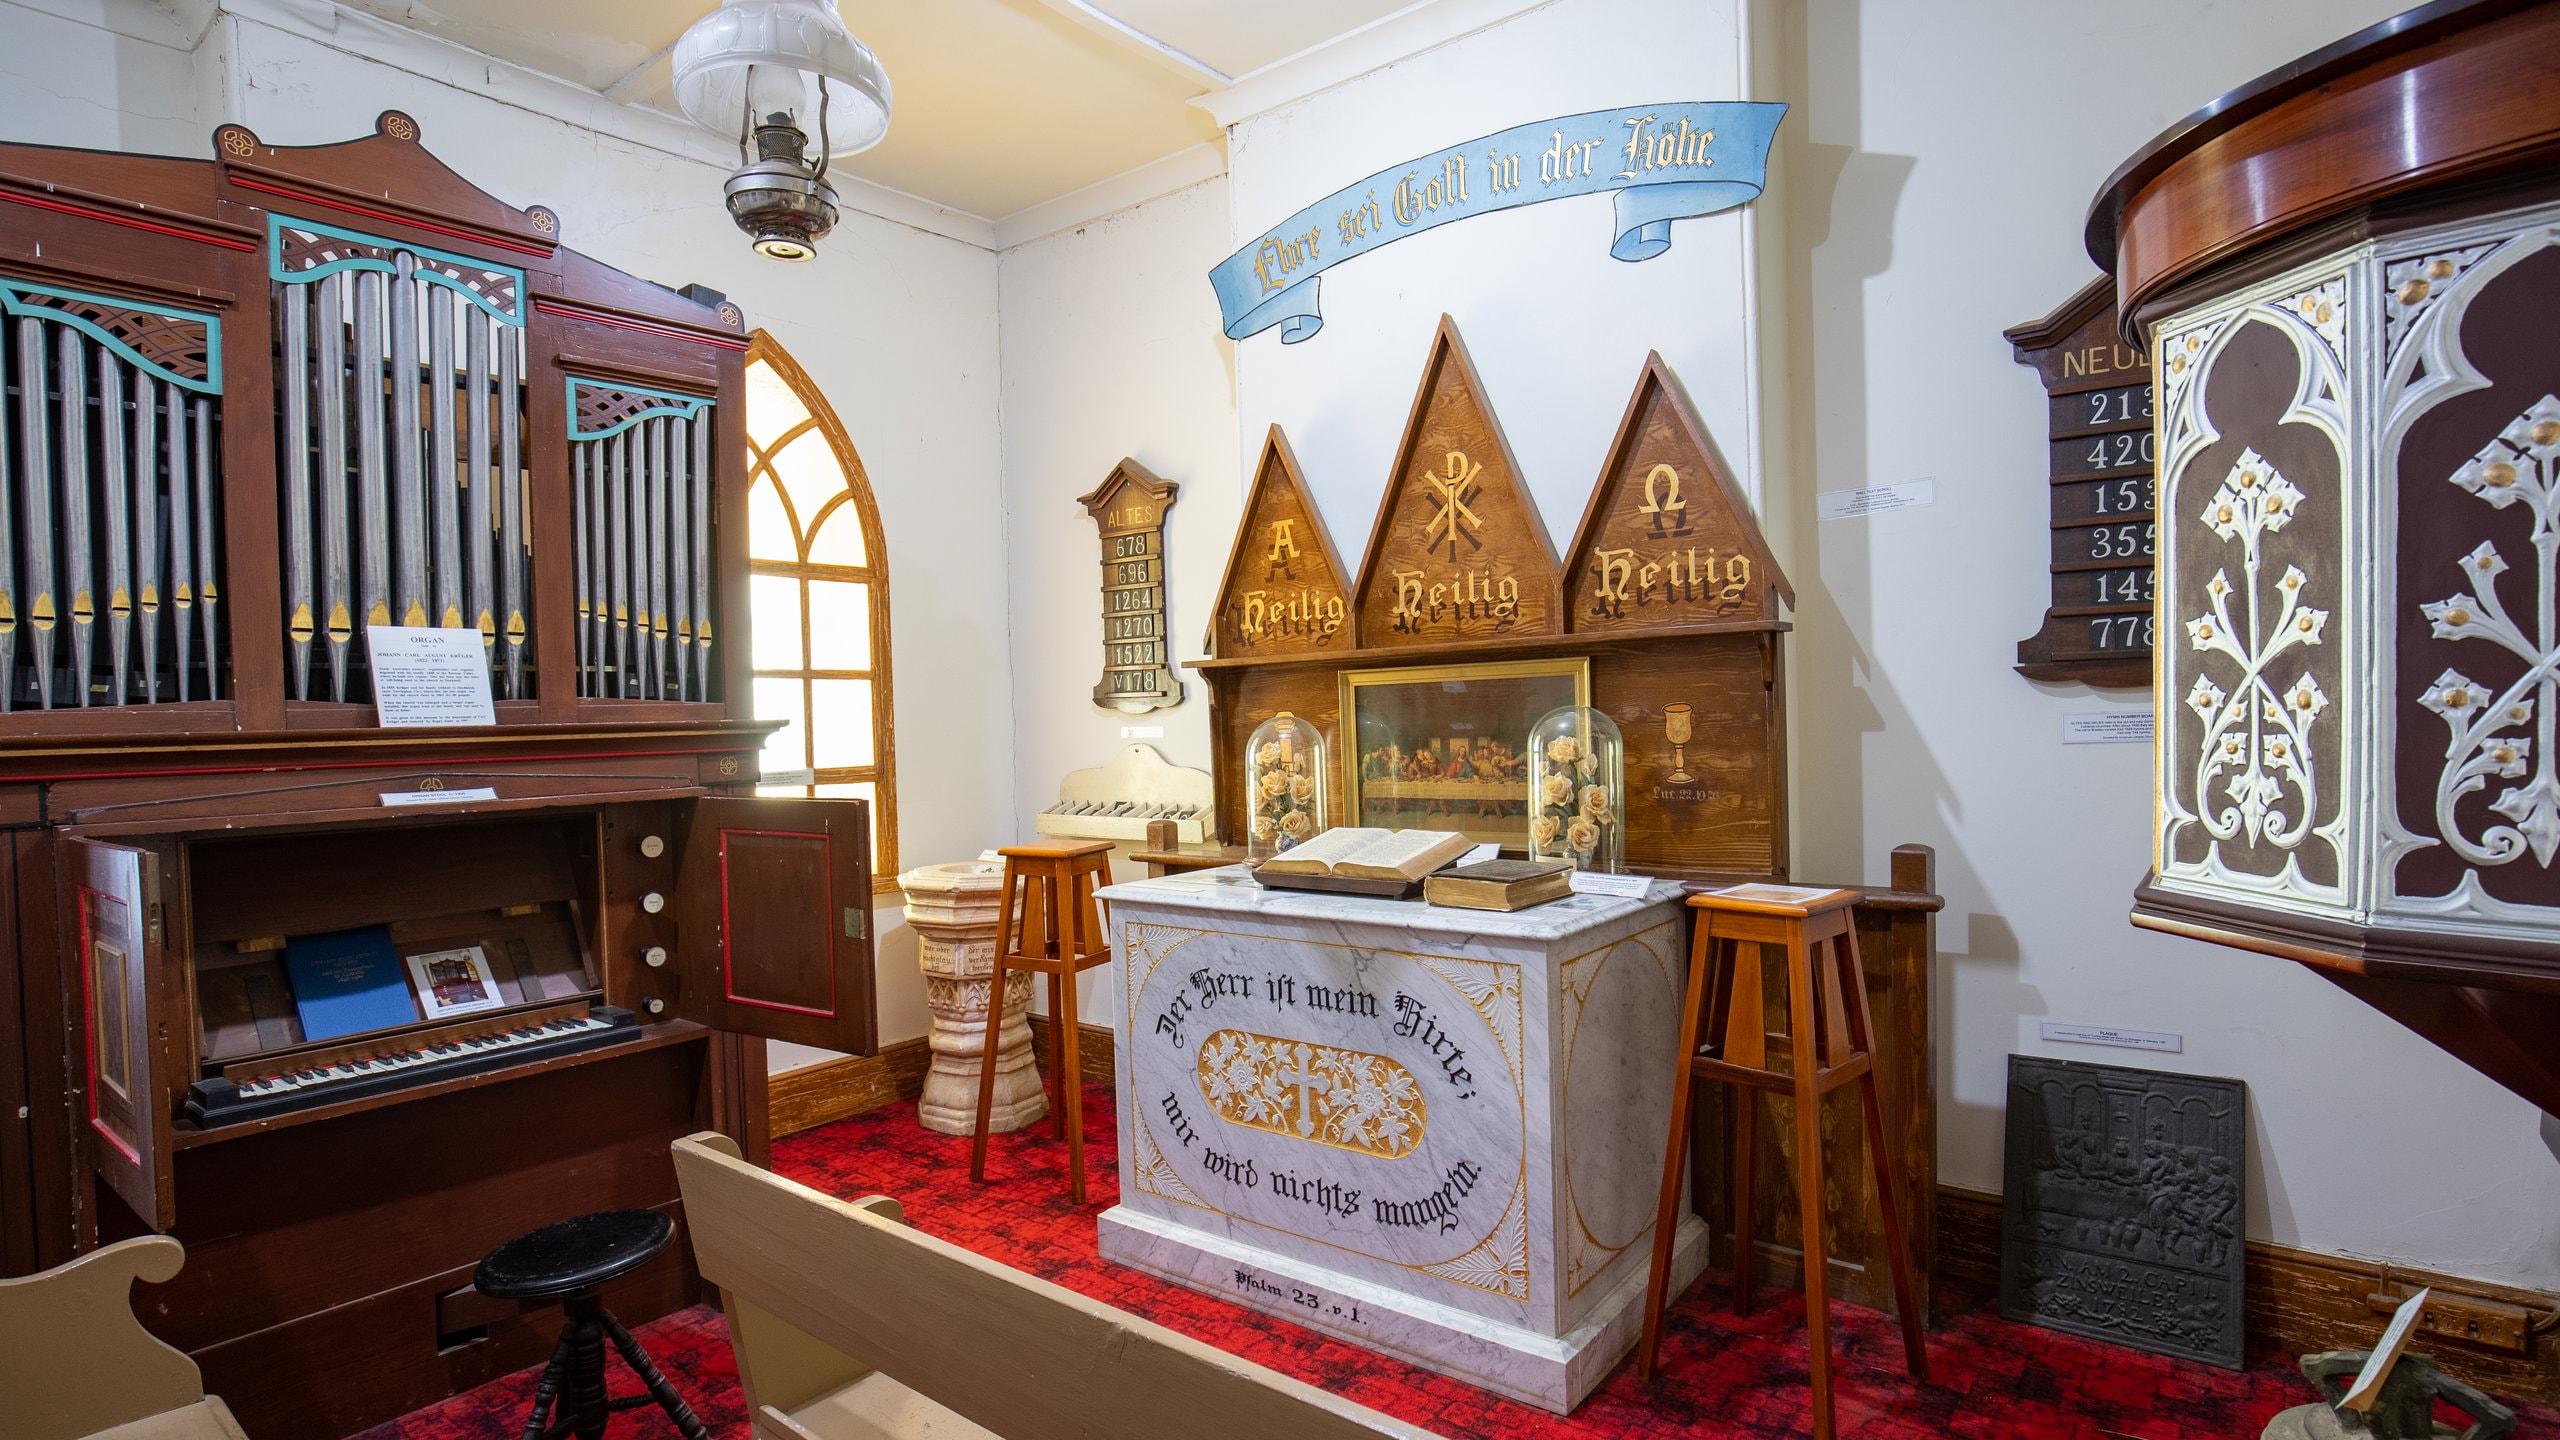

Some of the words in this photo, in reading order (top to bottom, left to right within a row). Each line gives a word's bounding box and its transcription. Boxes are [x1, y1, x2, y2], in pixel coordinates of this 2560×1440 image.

[1254, 225, 1321, 297] Ehre
[1338, 188, 1382, 247] sei
[1393, 151, 1470, 226] Gott
[1487, 147, 1523, 195] in
[1538, 129, 1604, 187] der
[1107, 506, 1153, 527] ALTES
[1116, 535, 1145, 556] 678
[1118, 563, 1146, 584] 696
[1593, 545, 1751, 601] Heilig
[1114, 589, 1151, 611] 1264
[1391, 569, 1518, 617] Heilig
[1240, 589, 1345, 633] Heilig
[1115, 617, 1152, 638] 1270
[1115, 644, 1154, 664] 1522
[1114, 671, 1154, 692] V178
[1155, 989, 1192, 1049] Der
[1190, 967, 1254, 1009] Herr
[1305, 983, 1379, 1019] mein
[1161, 1091, 1199, 1148] mir
[1203, 1147, 1259, 1189] wird
[1269, 1170, 1361, 1219] nichts
